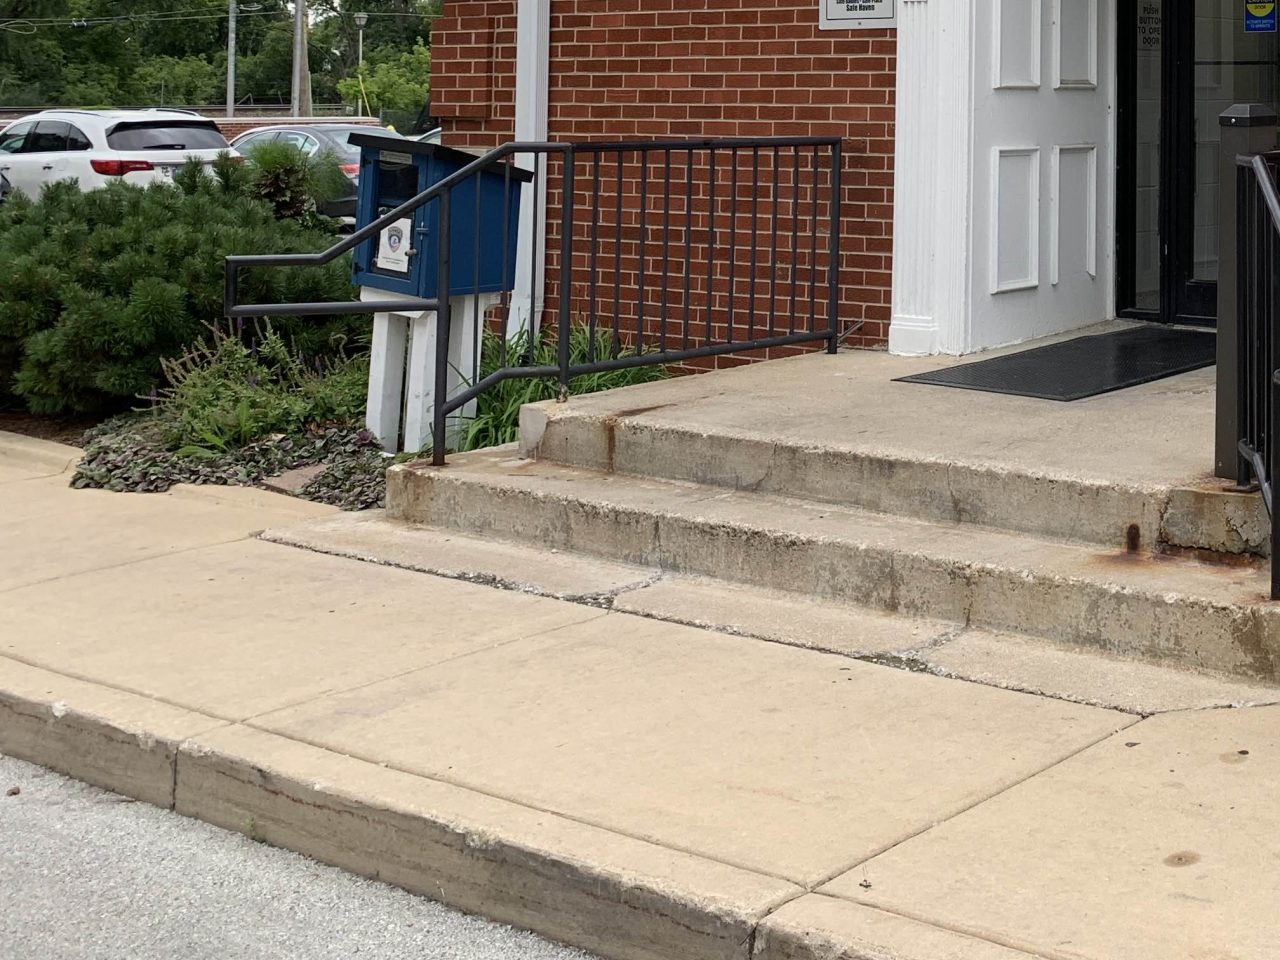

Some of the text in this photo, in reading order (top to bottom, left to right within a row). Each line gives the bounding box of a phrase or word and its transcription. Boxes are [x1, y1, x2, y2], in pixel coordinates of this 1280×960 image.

[1143, 6, 1159, 15] PUSH
[1149, 26, 1161, 35] OPE
[1143, 36, 1159, 45] DOOR
